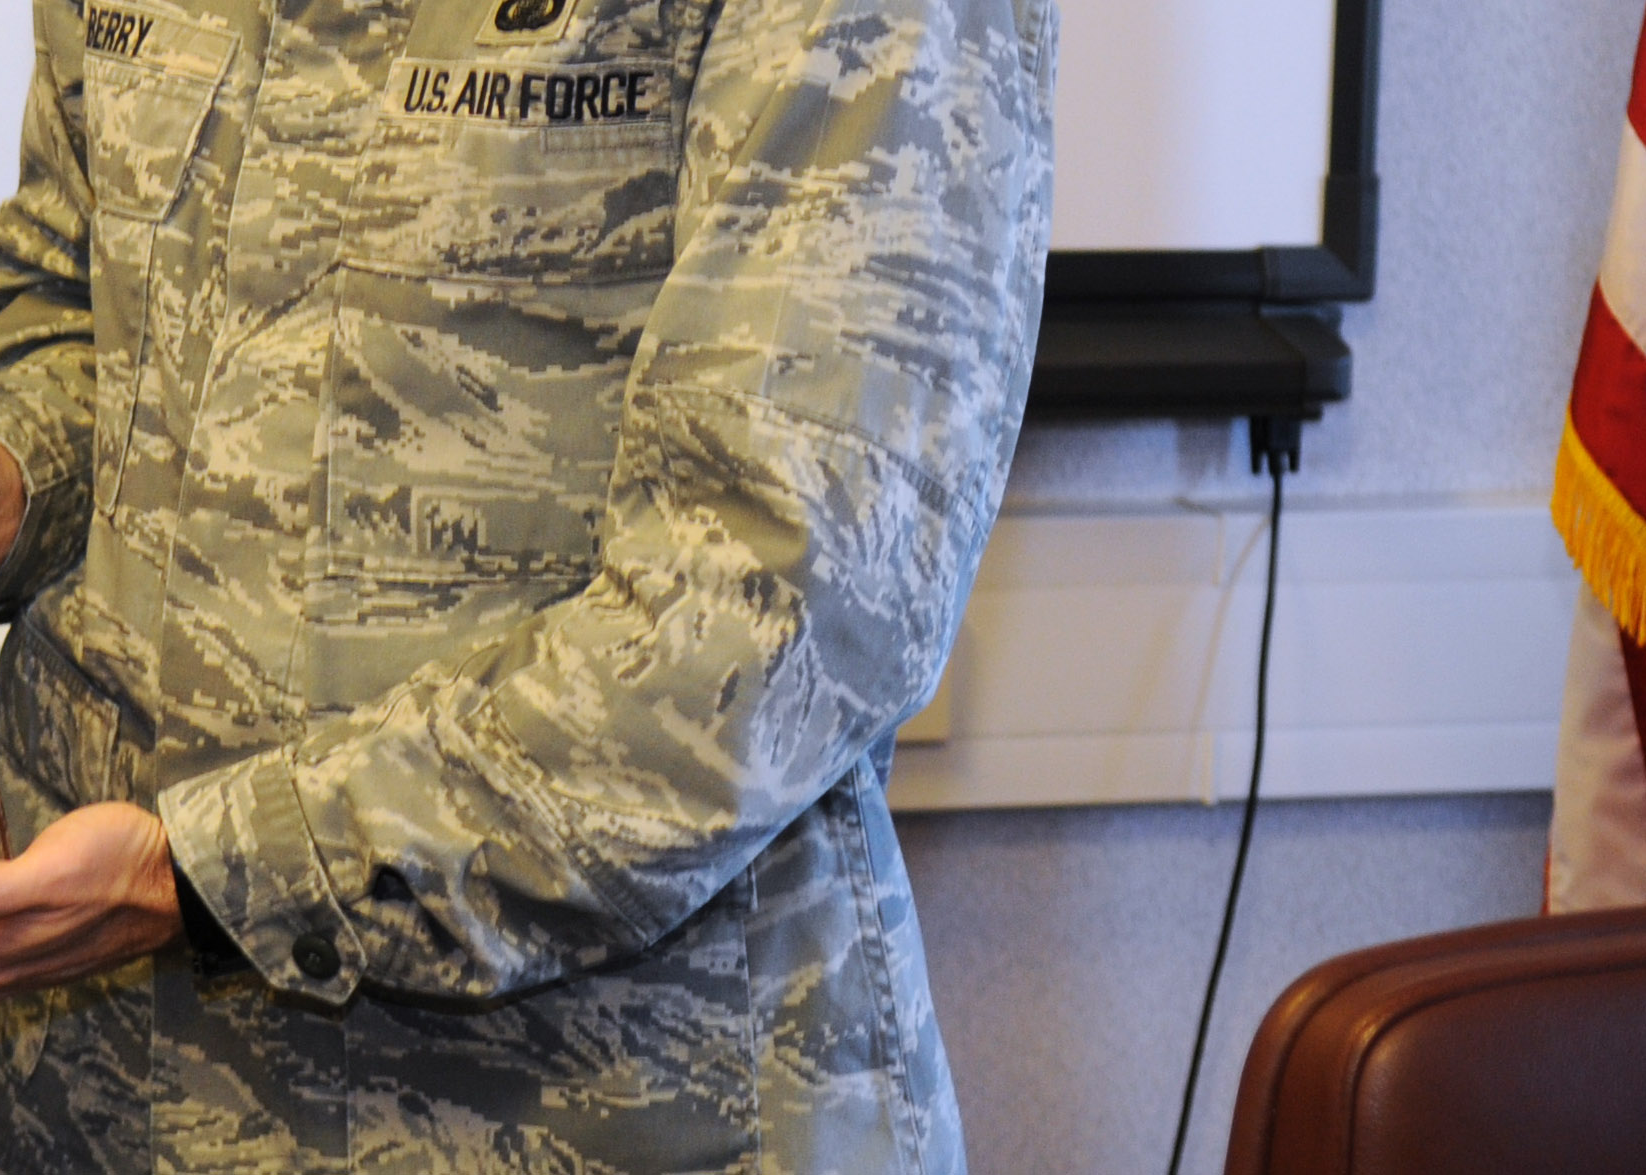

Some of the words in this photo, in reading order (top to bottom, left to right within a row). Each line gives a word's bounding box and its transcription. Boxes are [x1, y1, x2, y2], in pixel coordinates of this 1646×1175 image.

[85, 6, 154, 58] BERRY
[404, 67, 450, 114] U.S.
[451, 70, 511, 120] AIR
[519, 71, 655, 121] FORCE
